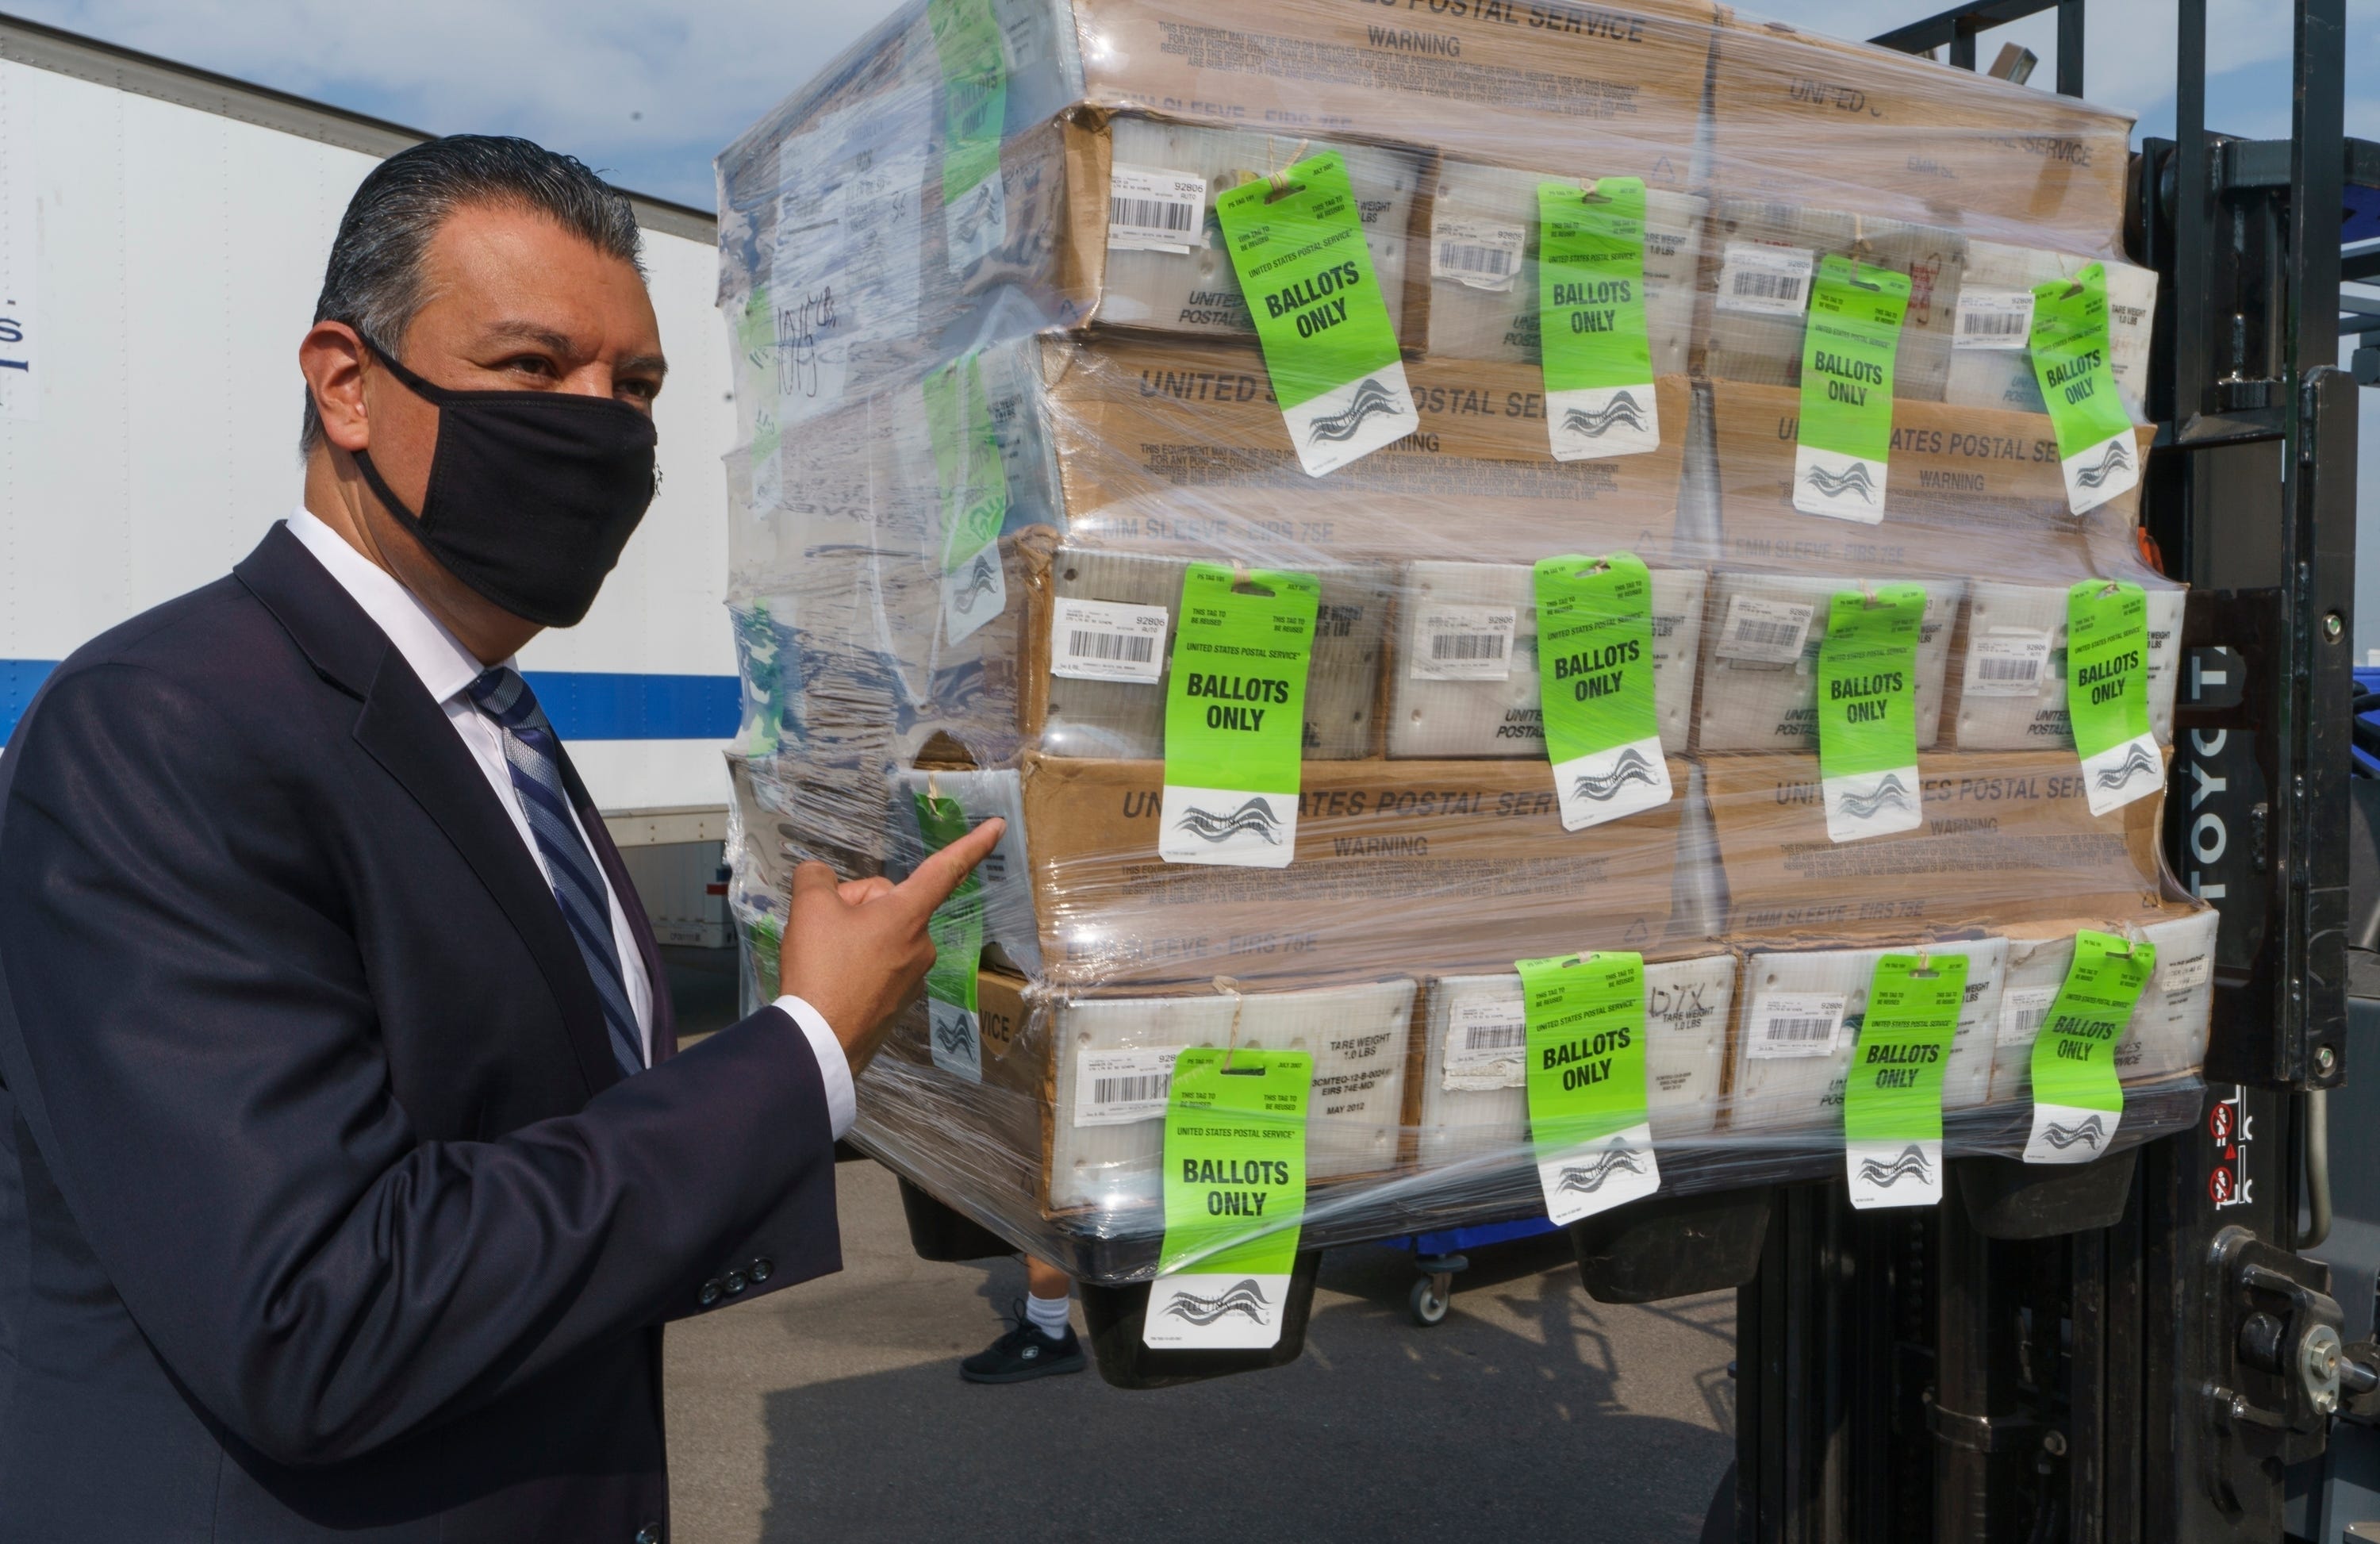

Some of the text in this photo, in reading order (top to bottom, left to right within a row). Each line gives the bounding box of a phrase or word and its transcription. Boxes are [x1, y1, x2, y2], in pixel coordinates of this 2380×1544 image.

[1409, 0, 1645, 43] POSTAL SERVICE
[1368, 25, 1460, 56] WARNING
[1790, 77, 1865, 113] UNIED
[1174, 182, 1203, 193] 92806
[1361, 202, 1391, 212] WEIGHT
[1361, 213, 1377, 222] LBS
[1249, 262, 1272, 278] UNITED
[1273, 253, 1297, 269] STATES
[1297, 242, 1322, 258] POSTAL
[1549, 254, 1569, 263] UNITED
[1570, 254, 1588, 263] STATES
[1590, 253, 1609, 262] POSTAL
[1190, 291, 1246, 307] UNITED
[1265, 260, 1360, 318] BALLOTS
[1553, 280, 1631, 305] BALLOTS
[1179, 309, 1231, 325] POSTAL
[1296, 297, 1347, 338] ONLY
[1571, 310, 1615, 333] ONLY
[2112, 304, 2146, 317] TARE WEIGHT
[1814, 324, 1832, 335] UNITED
[1833, 328, 1850, 339] STATES
[1850, 332, 1868, 344] POSTAL
[1814, 351, 1882, 385] BALLOTS
[2047, 349, 2101, 389] BALLOTS
[1140, 370, 1495, 415] UNITED OSTAL
[1828, 380, 1868, 406] ONLY
[2065, 377, 2094, 405] ONLY
[1889, 429, 2024, 460] ATES POSTAL
[1920, 470, 1983, 490] WARNING
[1137, 616, 1165, 626] 92806
[1547, 628, 1570, 640] UNITED
[1571, 624, 1593, 636] STATES
[1595, 619, 1616, 632] POSTAL
[1187, 643, 1212, 652] UNITED
[1215, 645, 1239, 655] STATES
[1241, 648, 1266, 657] POSTAL
[2075, 643, 2090, 654] UNITED
[2090, 638, 2106, 649] STATES
[2107, 633, 2123, 644] POSTAL
[2151, 639, 2162, 648] LBS
[1555, 639, 1640, 680] BALLOTS
[1827, 653, 1844, 663] UNITED
[1846, 651, 1864, 660] STATES
[1866, 650, 1883, 659] POSTAL
[2079, 651, 2139, 687] BALLOTS
[1187, 673, 1288, 704] BALLOTS
[1575, 671, 1623, 702] ONLY
[1831, 672, 1902, 700] BALLOTS
[2091, 678, 2125, 705] ONLY
[1207, 705, 1265, 732] ONLY
[1505, 709, 1543, 722] UNITE
[1847, 699, 1888, 724] ONLY
[2191, 647, 2227, 898] TOYOT
[1961, 778, 2040, 800] POSTAL
[1299, 791, 1484, 816] ATES POSTAL
[1931, 819, 1998, 834] WARNING
[1334, 837, 1428, 857] WARNING
[1787, 906, 1845, 924] SLEEVE
[1860, 903, 1894, 920] EIRS
[1898, 900, 1924, 918] 75E
[1965, 981, 1990, 993] WEIGHT
[1966, 993, 1978, 1002] LBS
[2066, 993, 2080, 1002] UNITED
[979, 1008, 1010, 1043] VICE
[1536, 1019, 1558, 1031] UNITED
[1560, 1013, 1582, 1026] STATES
[1583, 1008, 1606, 1020] POSTAL
[1663, 1011, 1683, 1023] TARE
[1674, 1018, 1702, 1031] 1.0 LBS
[2053, 1016, 2116, 1040] BALLOTS
[1330, 1032, 1391, 1050] TARE WEIGHT
[1543, 1027, 1631, 1070] BALLOTS
[2057, 1039, 2093, 1062] ONLY
[1344, 1047, 1376, 1059] 1.0 LBS
[1866, 1044, 1940, 1064] BALLOTS
[1563, 1058, 1612, 1092] ONLY
[1875, 1068, 1919, 1089] ONLY
[1322, 1086, 1342, 1096] EIRS
[1326, 1103, 1365, 1115] MAY 2012
[1177, 1127, 1203, 1136] UNITED
[1206, 1128, 1231, 1137] STATES
[1234, 1129, 1261, 1138] POSTAL
[1183, 1160, 1288, 1185] BALLOTS
[1207, 1192, 1267, 1216] ONLY
